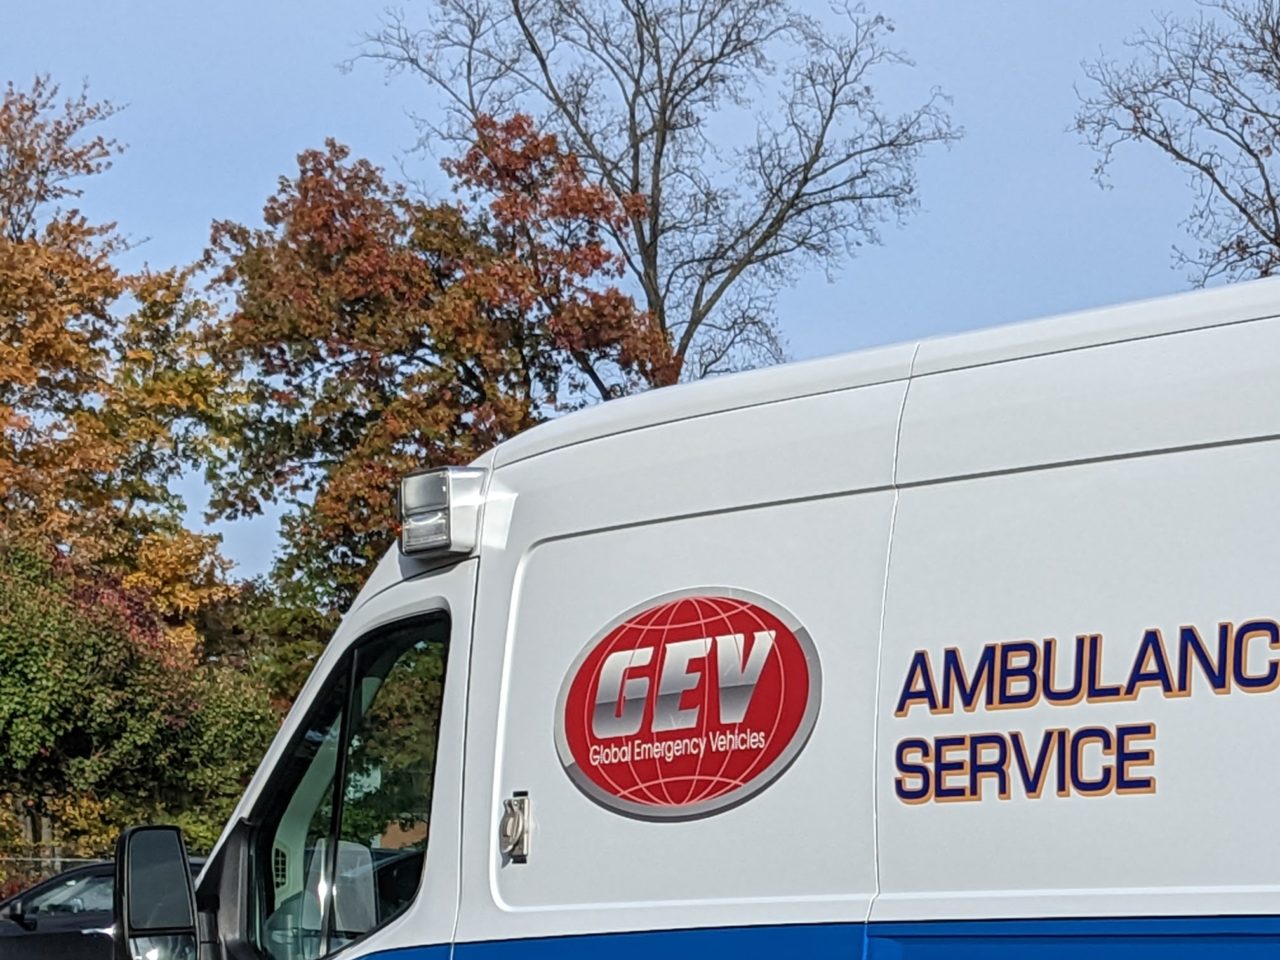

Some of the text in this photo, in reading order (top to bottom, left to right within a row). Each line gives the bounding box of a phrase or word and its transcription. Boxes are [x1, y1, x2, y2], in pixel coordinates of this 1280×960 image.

[592, 630, 776, 739] GEV
[589, 729, 766, 766] Global Emergency Vehicles
[894, 722, 1157, 805] SERVICE
